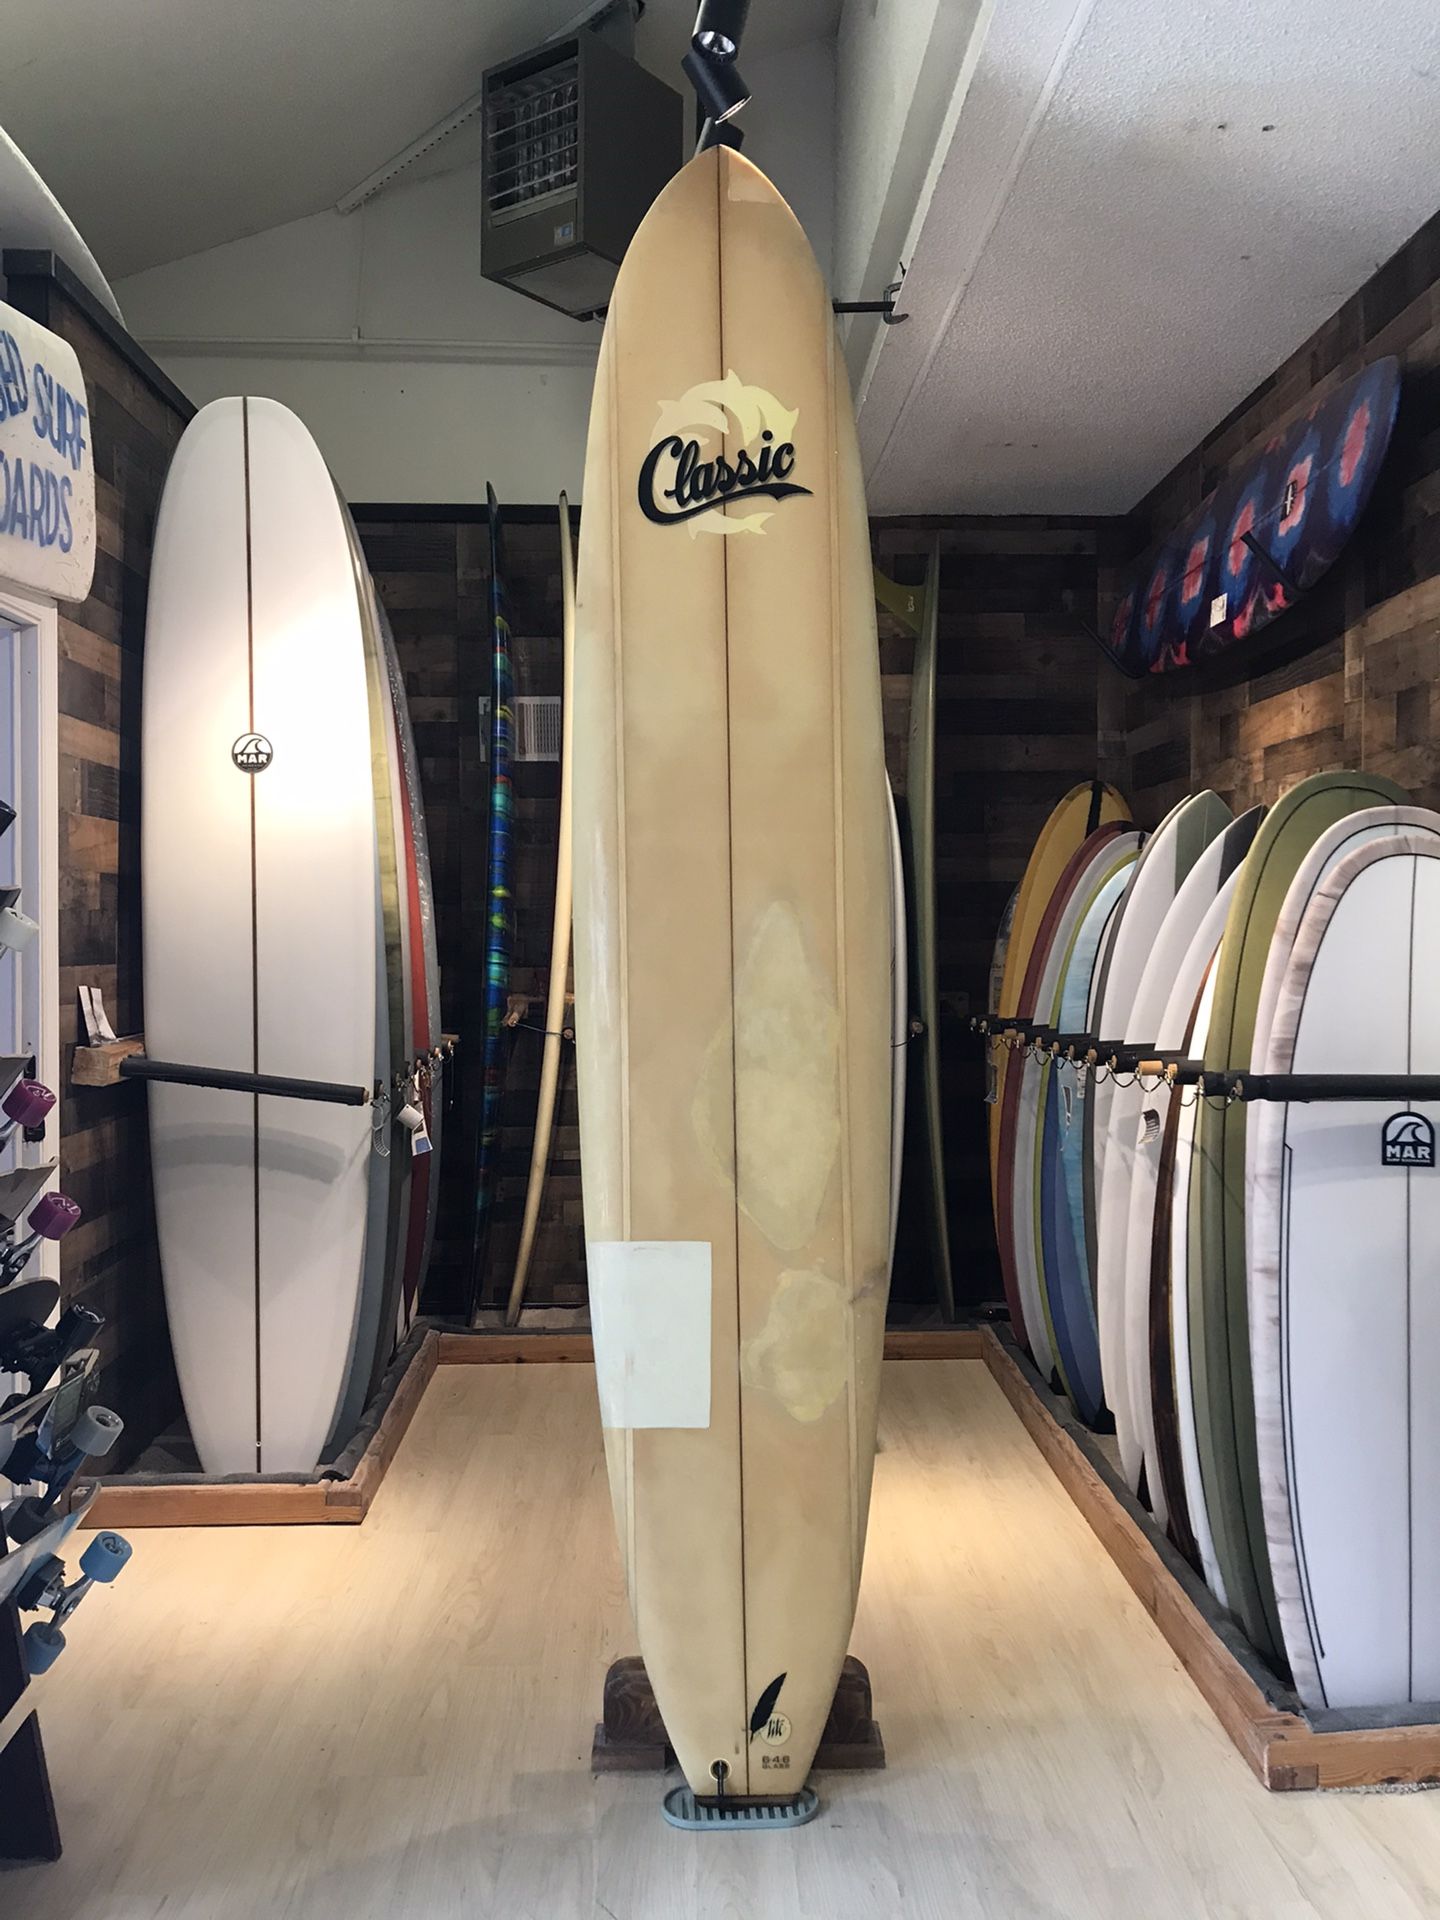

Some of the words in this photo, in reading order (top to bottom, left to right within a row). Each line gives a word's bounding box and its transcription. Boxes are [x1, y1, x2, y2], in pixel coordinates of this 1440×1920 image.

[0, 330, 28, 421] ED
[33, 363, 86, 471] SURF
[638, 434, 813, 523] Classic
[237, 753, 268, 764] MAR
[1386, 1144, 1431, 1159] MAR
